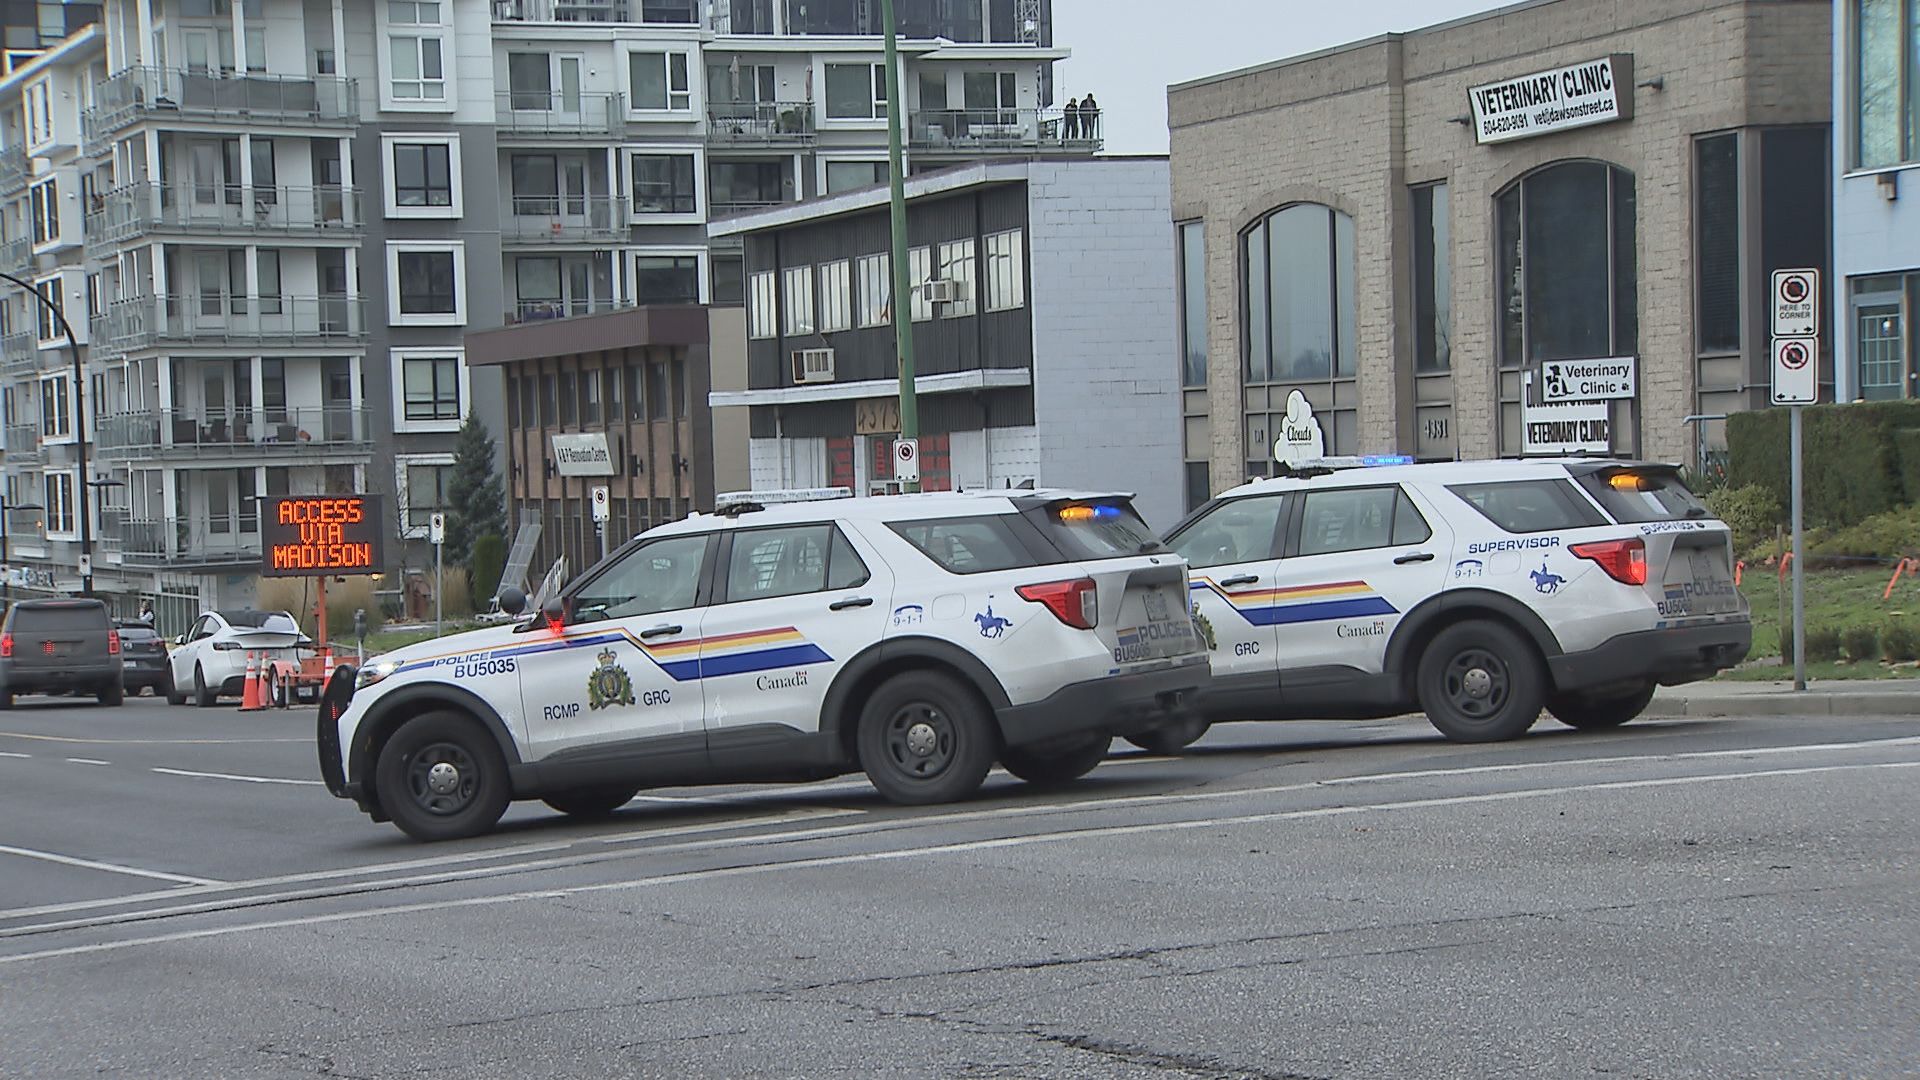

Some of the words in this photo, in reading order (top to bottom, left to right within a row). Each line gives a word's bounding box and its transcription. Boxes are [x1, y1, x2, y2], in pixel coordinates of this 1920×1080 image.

[1476, 74, 1557, 116] VETERINARY
[1562, 63, 1611, 98] CLINIC
[1533, 98, 1614, 126] vet@dawsonstreet.ca
[1779, 311, 1811, 319] CORNER
[1565, 364, 1630, 378] Veterinary
[1580, 382, 1616, 394] Clinic
[1287, 425, 1312, 443] Clouds
[1527, 420, 1578, 444] VETERINARY
[1580, 420, 1608, 442] CLINIC
[278, 499, 363, 524] ACCESS
[300, 522, 344, 545] VIA
[1641, 522, 1694, 535] SUPERVISOR
[1469, 537, 1560, 554] SUPERVISOR
[273, 543, 371, 569] MADISON
[1455, 568, 1483, 579] 9-1-1
[1684, 580, 1725, 599] POLICE
[894, 615, 923, 626] 9-1-1
[1138, 621, 1183, 643] POLICE
[1337, 622, 1384, 638] Canada
[1234, 641, 1260, 656] GRC
[436, 652, 490, 666] POLICE
[455, 658, 515, 678] BU5035
[756, 672, 808, 691] Canada
[544, 703, 580, 720] RCMP
[643, 690, 671, 706] GRC
